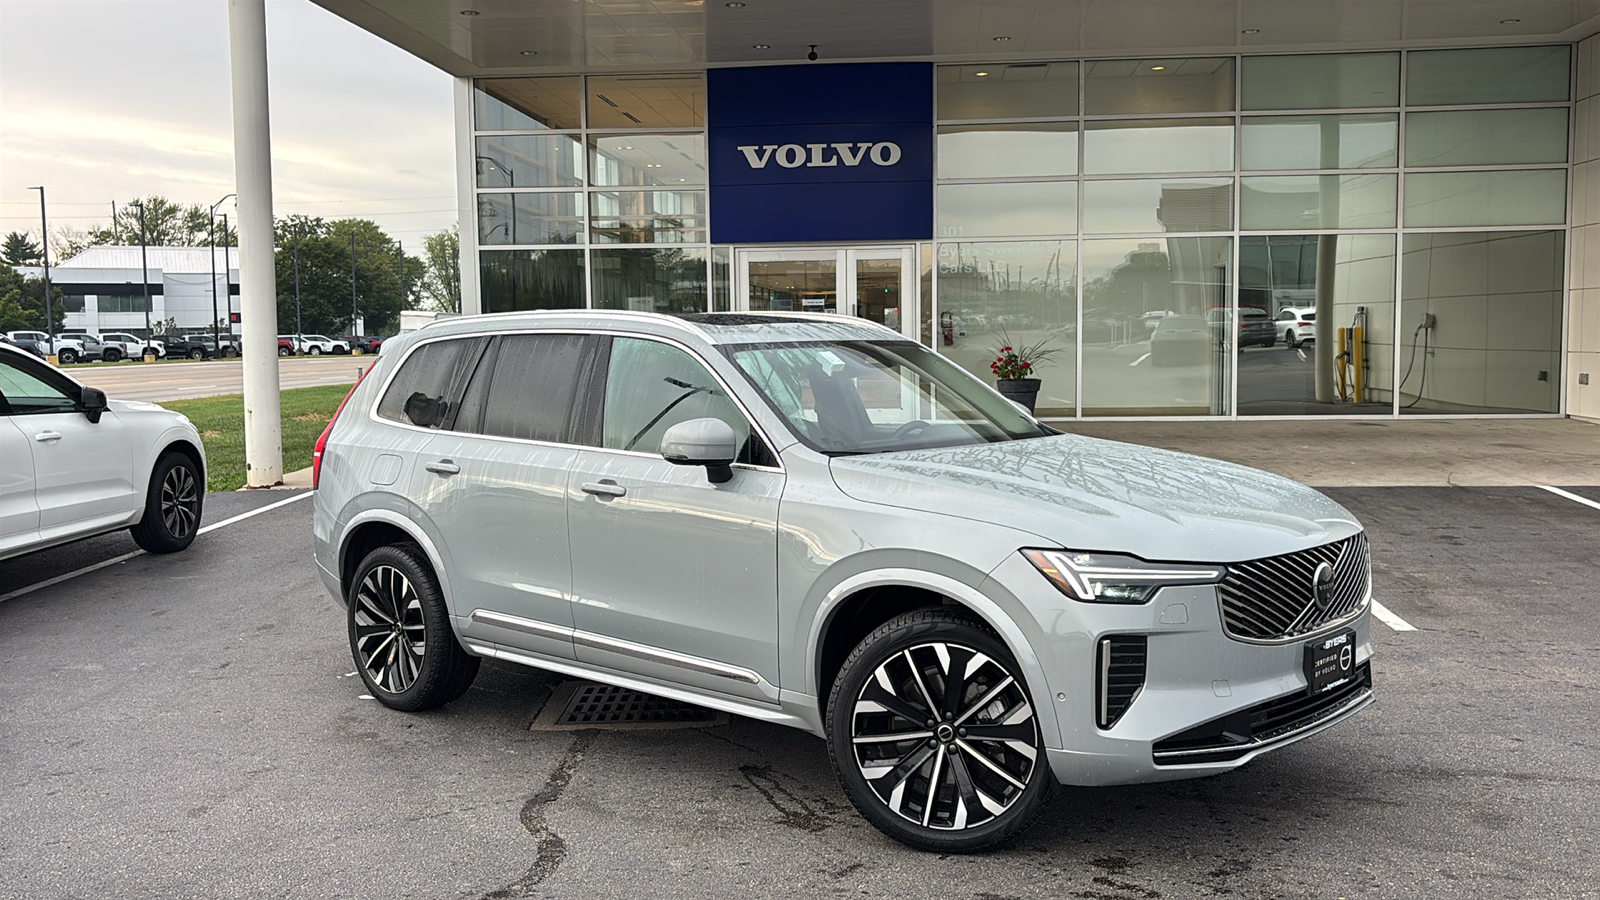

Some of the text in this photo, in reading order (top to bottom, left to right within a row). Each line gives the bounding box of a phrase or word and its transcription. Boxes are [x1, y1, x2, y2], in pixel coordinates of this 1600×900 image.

[737, 141, 902, 169] VOLVO
[940, 243, 1048, 259] Byers Swedish
[939, 260, 1006, 274] Cars LLC
[1325, 634, 1346, 649] BYERS
[1315, 654, 1338, 668] CERTIFIED
[1315, 664, 1336, 678] BY VOLVO
